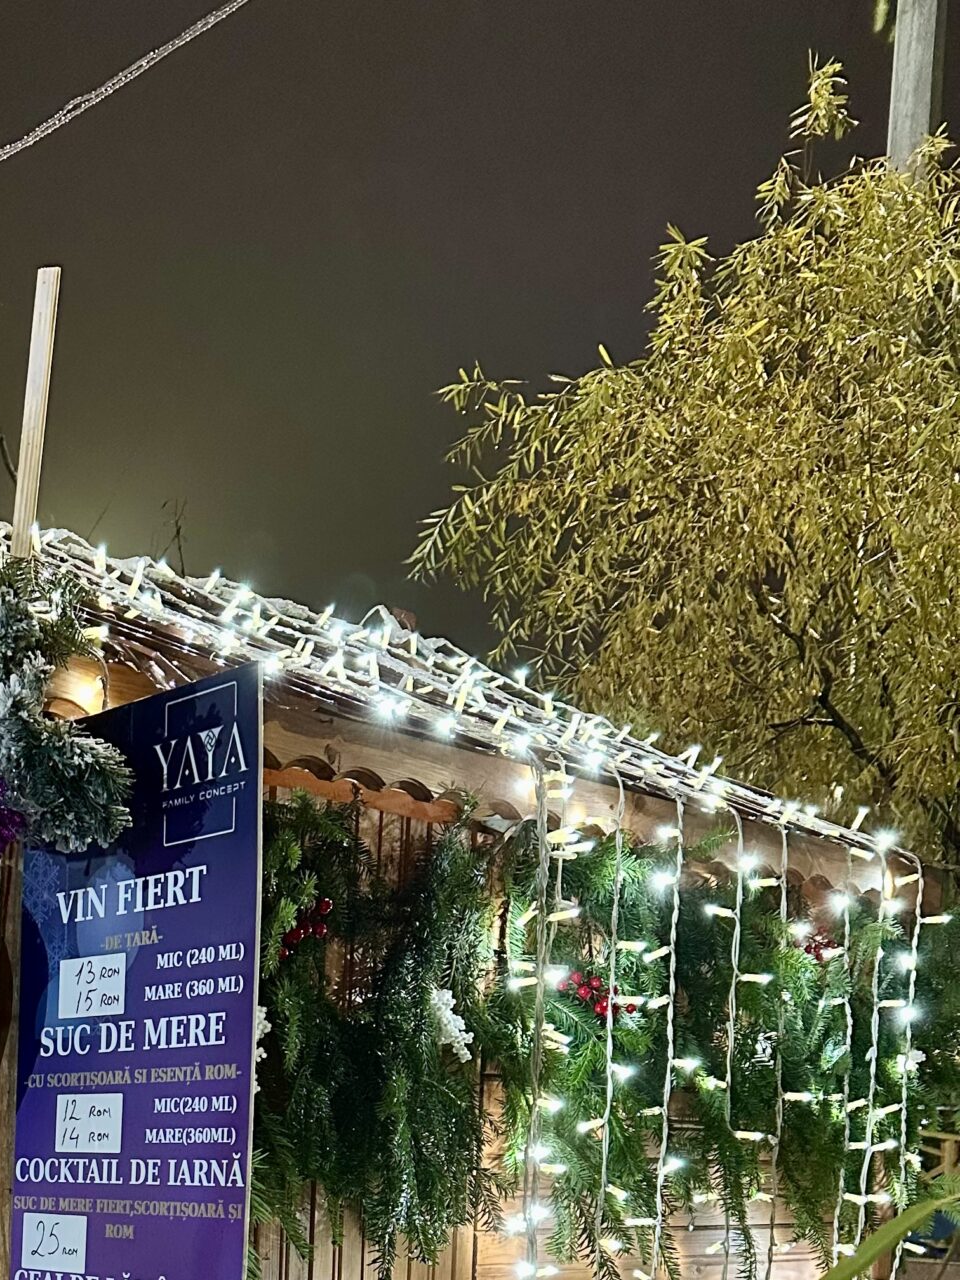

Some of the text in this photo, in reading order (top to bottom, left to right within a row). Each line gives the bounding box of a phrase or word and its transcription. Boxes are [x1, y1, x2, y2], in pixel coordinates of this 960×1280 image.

[153, 721, 250, 793] YAYA
[162, 781, 246, 809] FAMILY CONCEPT
[56, 865, 207, 924] VIN FIERT
[156, 942, 245, 970] MIC (240 ML)
[75, 960, 120, 986] 13 RON
[75, 988, 97, 1014] 15
[143, 975, 244, 1002] MARE (360 ML)
[40, 1012, 227, 1057] SUC DE MERE
[63, 1099, 81, 1122] 12
[154, 1095, 237, 1115] MIC(240 ML)
[61, 1126, 80, 1149] 14
[145, 1127, 237, 1145] MARE(360ML)
[15, 1151, 245, 1188] COCKTAIL DE IARNĂ
[14, 1195, 38, 1210] SUC
[39, 1197, 56, 1211] DE
[58, 1197, 93, 1213] MERE
[31, 1220, 60, 1257] 25
[105, 1223, 135, 1240] ROM
